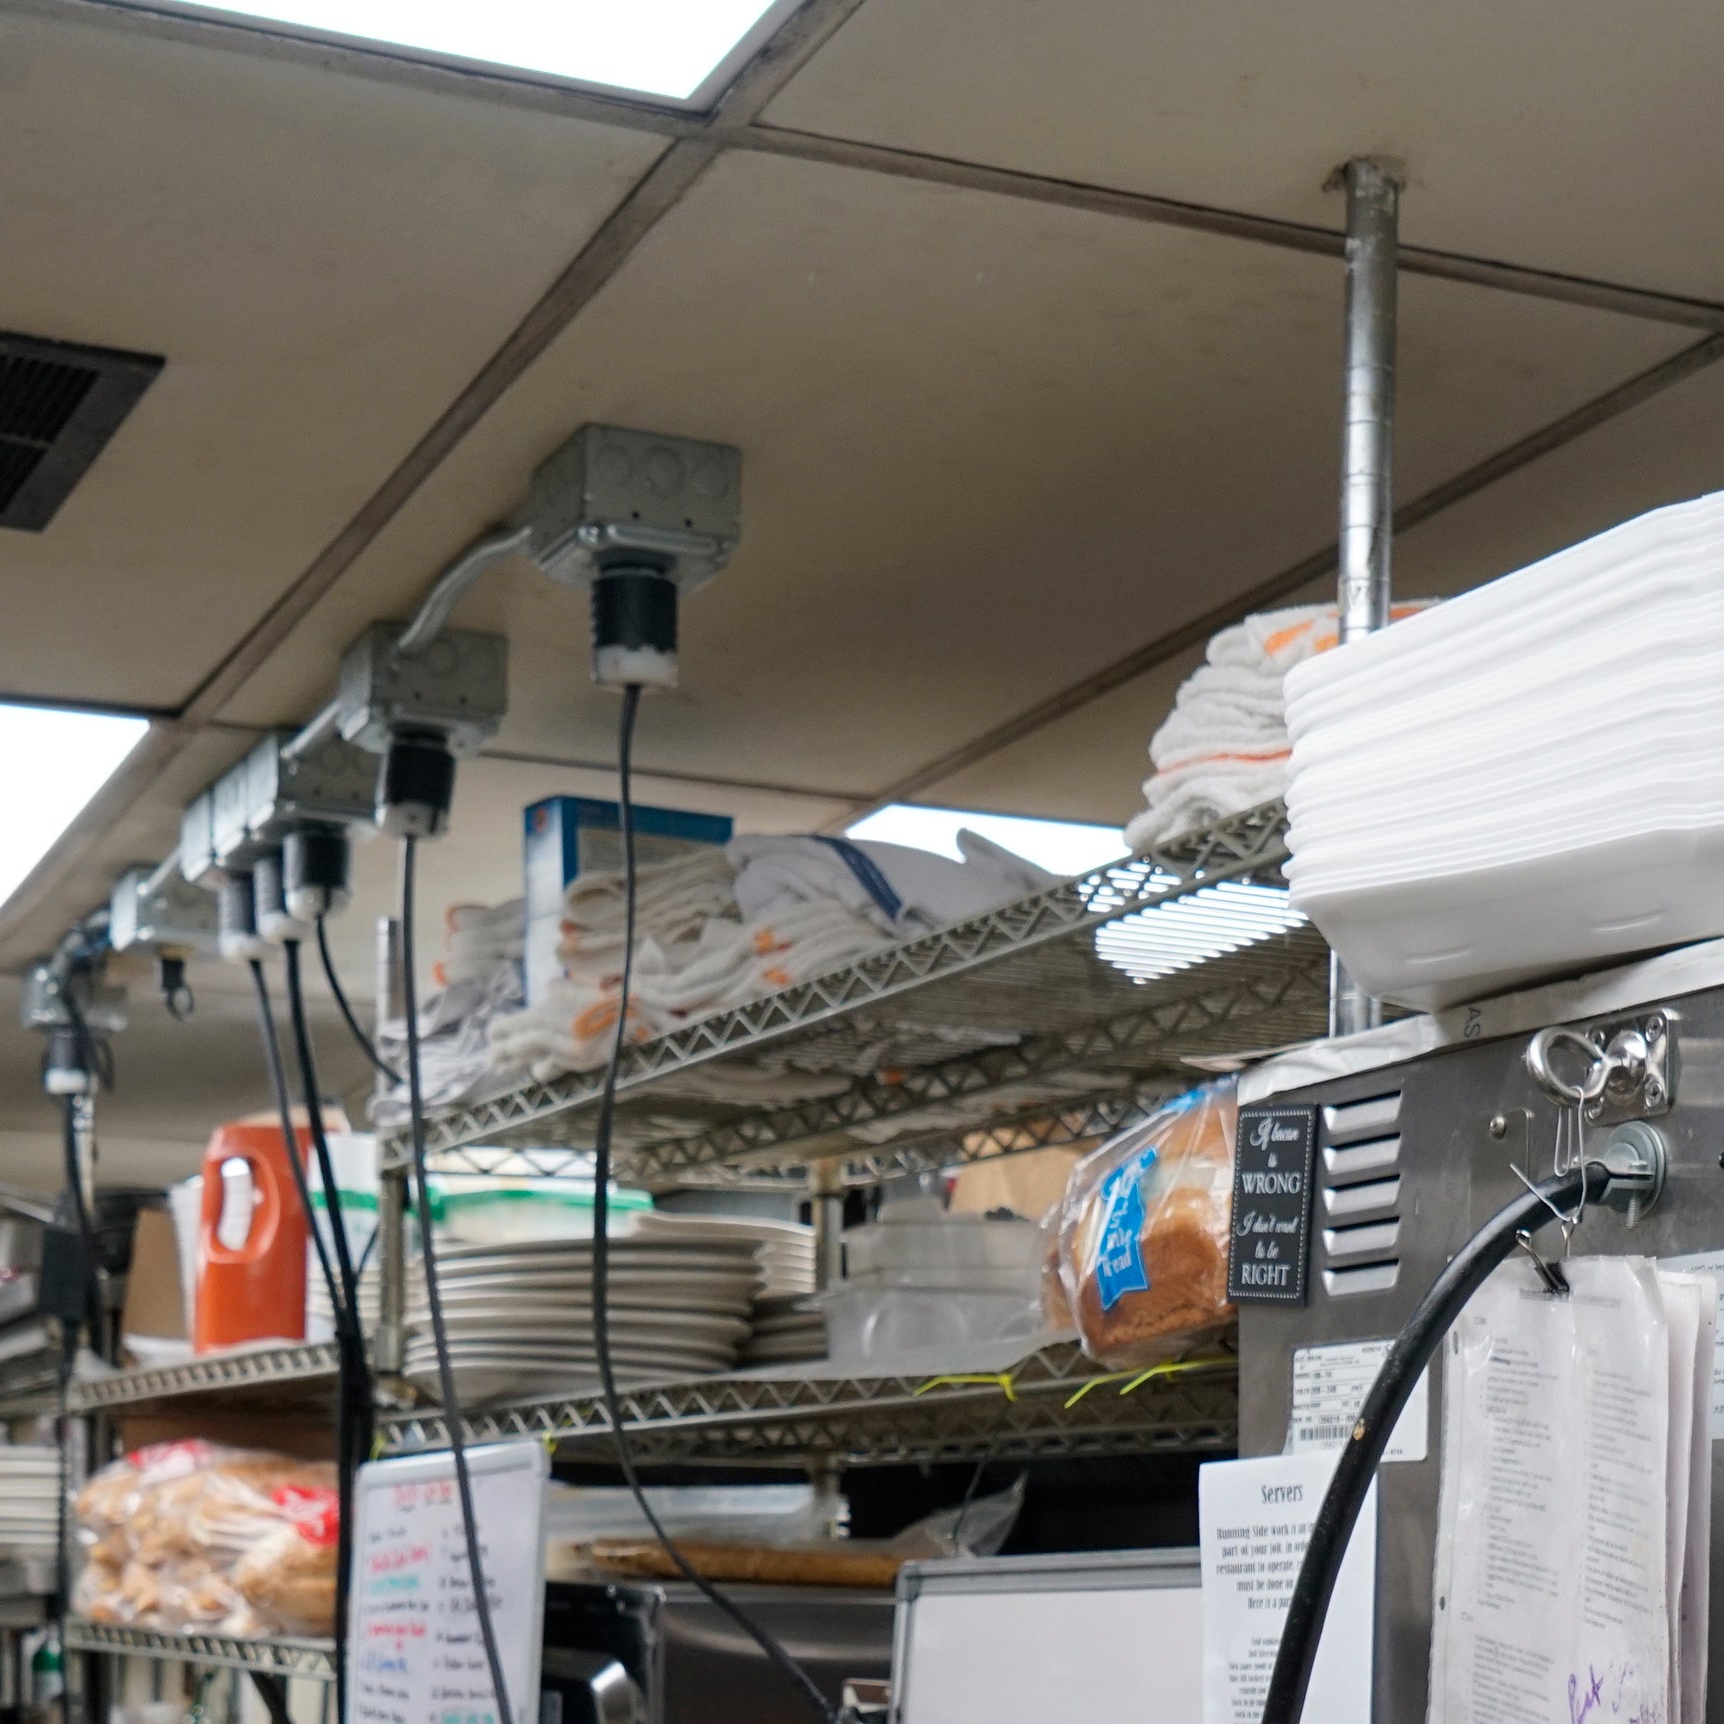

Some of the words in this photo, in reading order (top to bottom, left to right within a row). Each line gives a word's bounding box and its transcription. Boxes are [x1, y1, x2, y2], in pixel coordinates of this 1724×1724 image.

[1242, 1172, 1301, 1194] WRONG
[1241, 1264, 1290, 1286] RIGHT
[1261, 1484, 1303, 1504] Servers
[1217, 1527, 1250, 1539] Running
[1271, 1524, 1288, 1536] work
